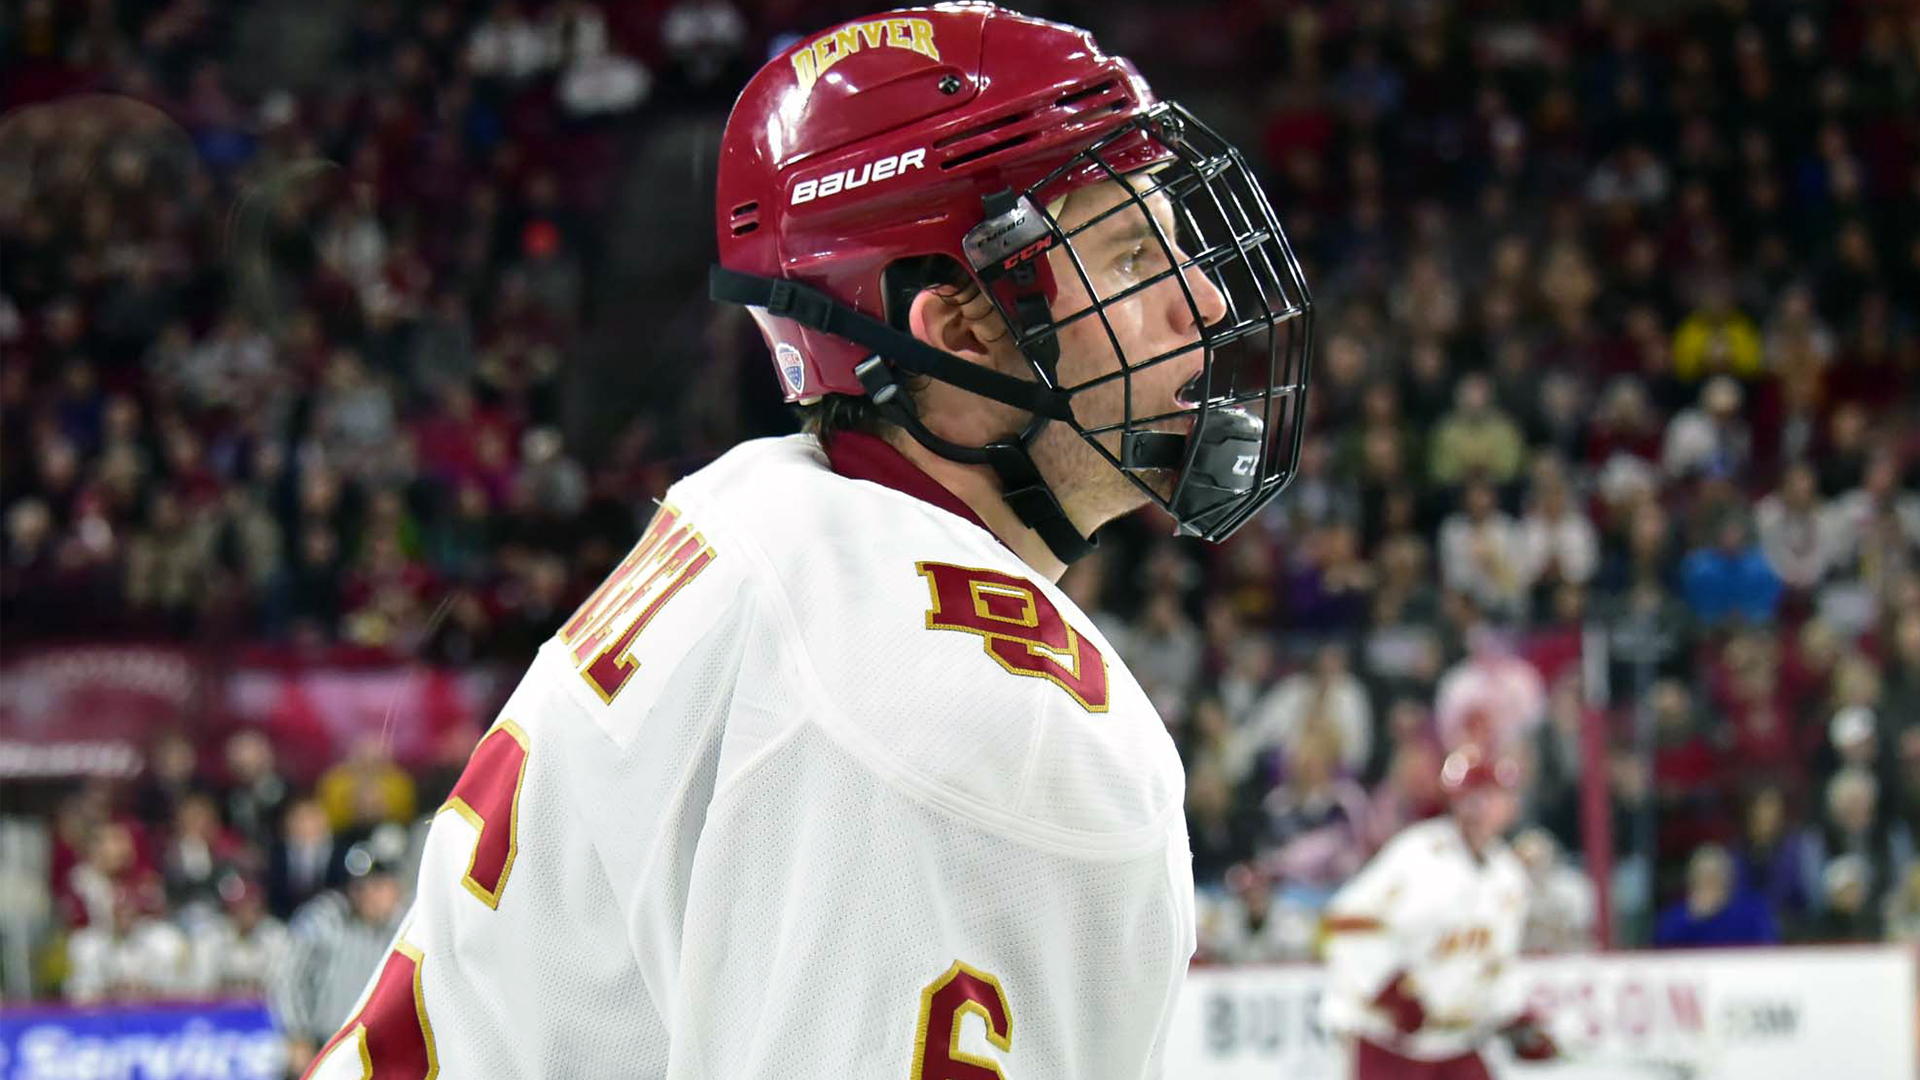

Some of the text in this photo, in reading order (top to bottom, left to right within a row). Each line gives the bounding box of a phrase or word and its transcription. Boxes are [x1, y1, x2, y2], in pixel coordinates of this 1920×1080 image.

[791, 18, 940, 92] DENVER
[791, 148, 926, 205] BAUER
[1004, 235, 1052, 270] CCM
[915, 561, 1109, 713] DU
[910, 959, 1013, 1080] 6
